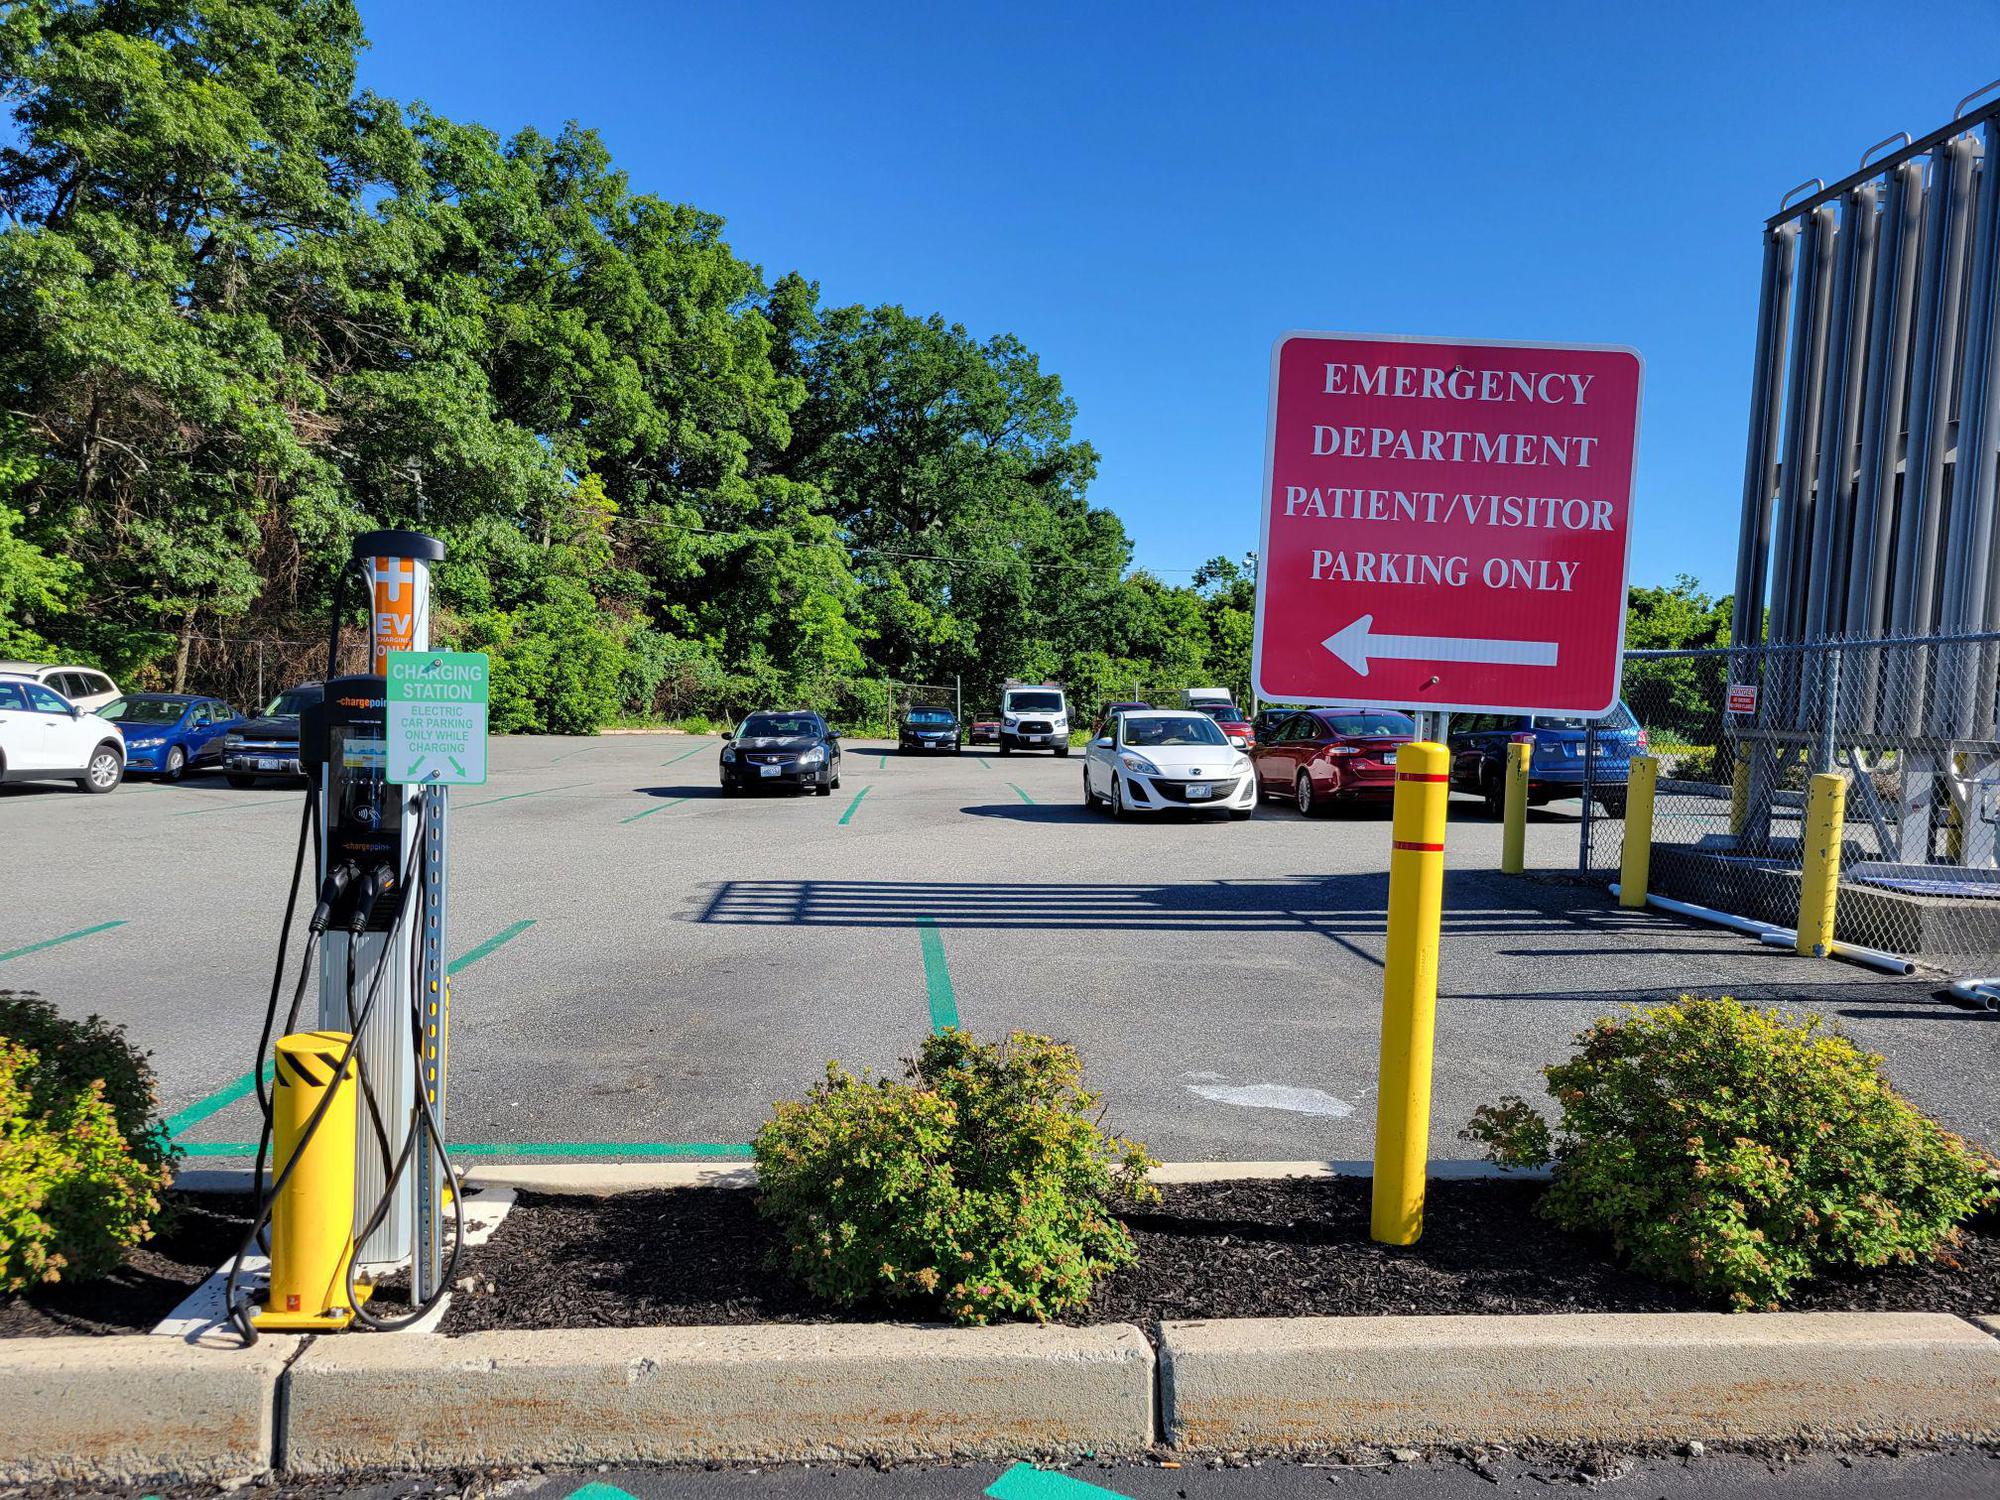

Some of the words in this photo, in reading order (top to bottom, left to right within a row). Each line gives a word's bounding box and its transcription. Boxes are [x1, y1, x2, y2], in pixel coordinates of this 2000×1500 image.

[1322, 363, 1595, 405] EMERGENCY
[1311, 425, 1598, 468] DEPARTMENT
[1283, 486, 1615, 532] PATIENT/VISITOR
[1310, 550, 1469, 587] PARKING
[1483, 558, 1580, 592] ONLY
[376, 612, 411, 635] EV
[392, 663, 482, 682] CHARGING
[402, 683, 473, 700] STATION
[411, 705, 464, 717] ELECTRIC
[400, 717, 424, 728] CAR
[426, 718, 473, 729] PARKING
[405, 729, 433, 740] ONLY
[436, 731, 469, 741] WHILE
[408, 742, 465, 753] CHARGING
